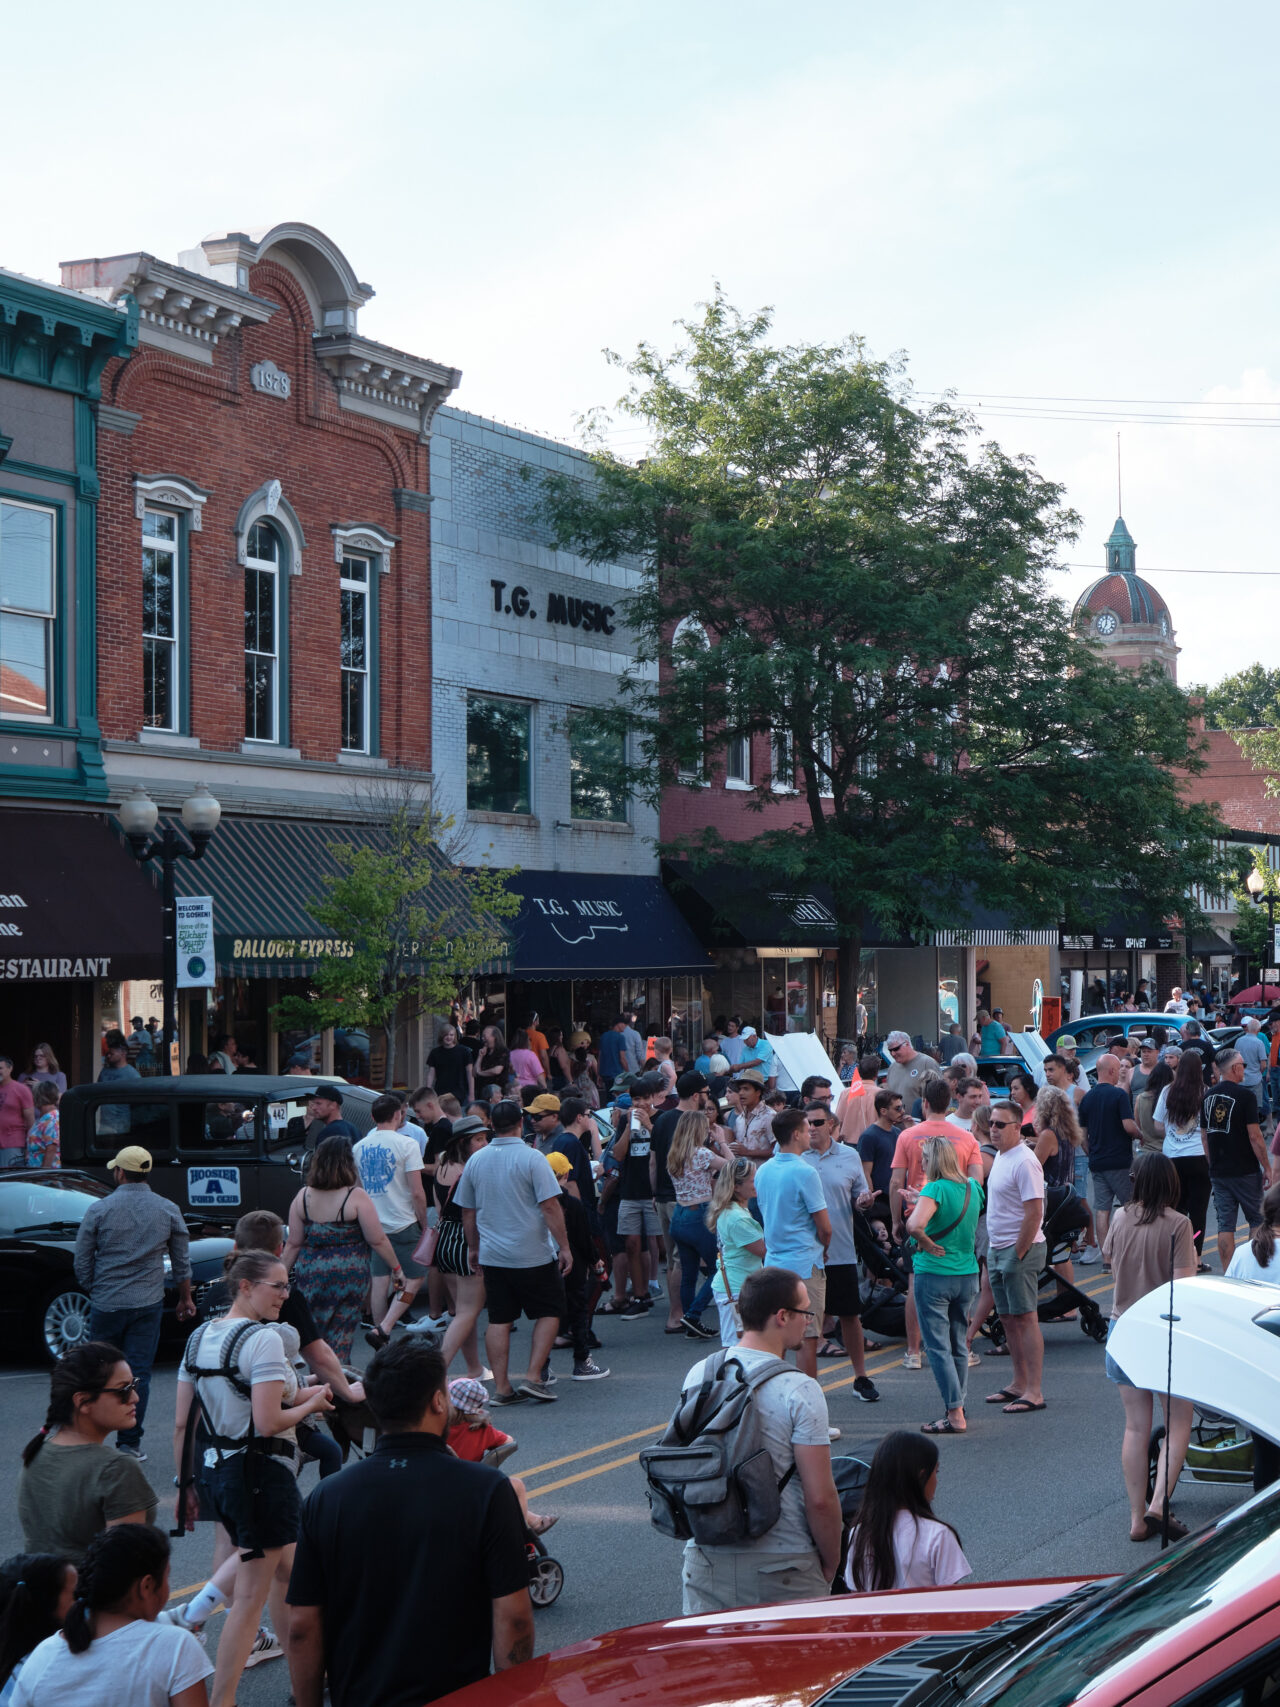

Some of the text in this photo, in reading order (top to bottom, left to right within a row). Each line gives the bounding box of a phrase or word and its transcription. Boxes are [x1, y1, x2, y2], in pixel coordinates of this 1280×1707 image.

[259, 370, 288, 393] 1878
[490, 579, 616, 636] T.G. MUSIC
[533, 898, 623, 916] T.G. MUSIC
[273, 1108, 285, 1120] 442
[190, 1169, 238, 1185] HOOSIER
[205, 1179, 224, 1194] A
[191, 1195, 239, 1204] FORD CLUB
